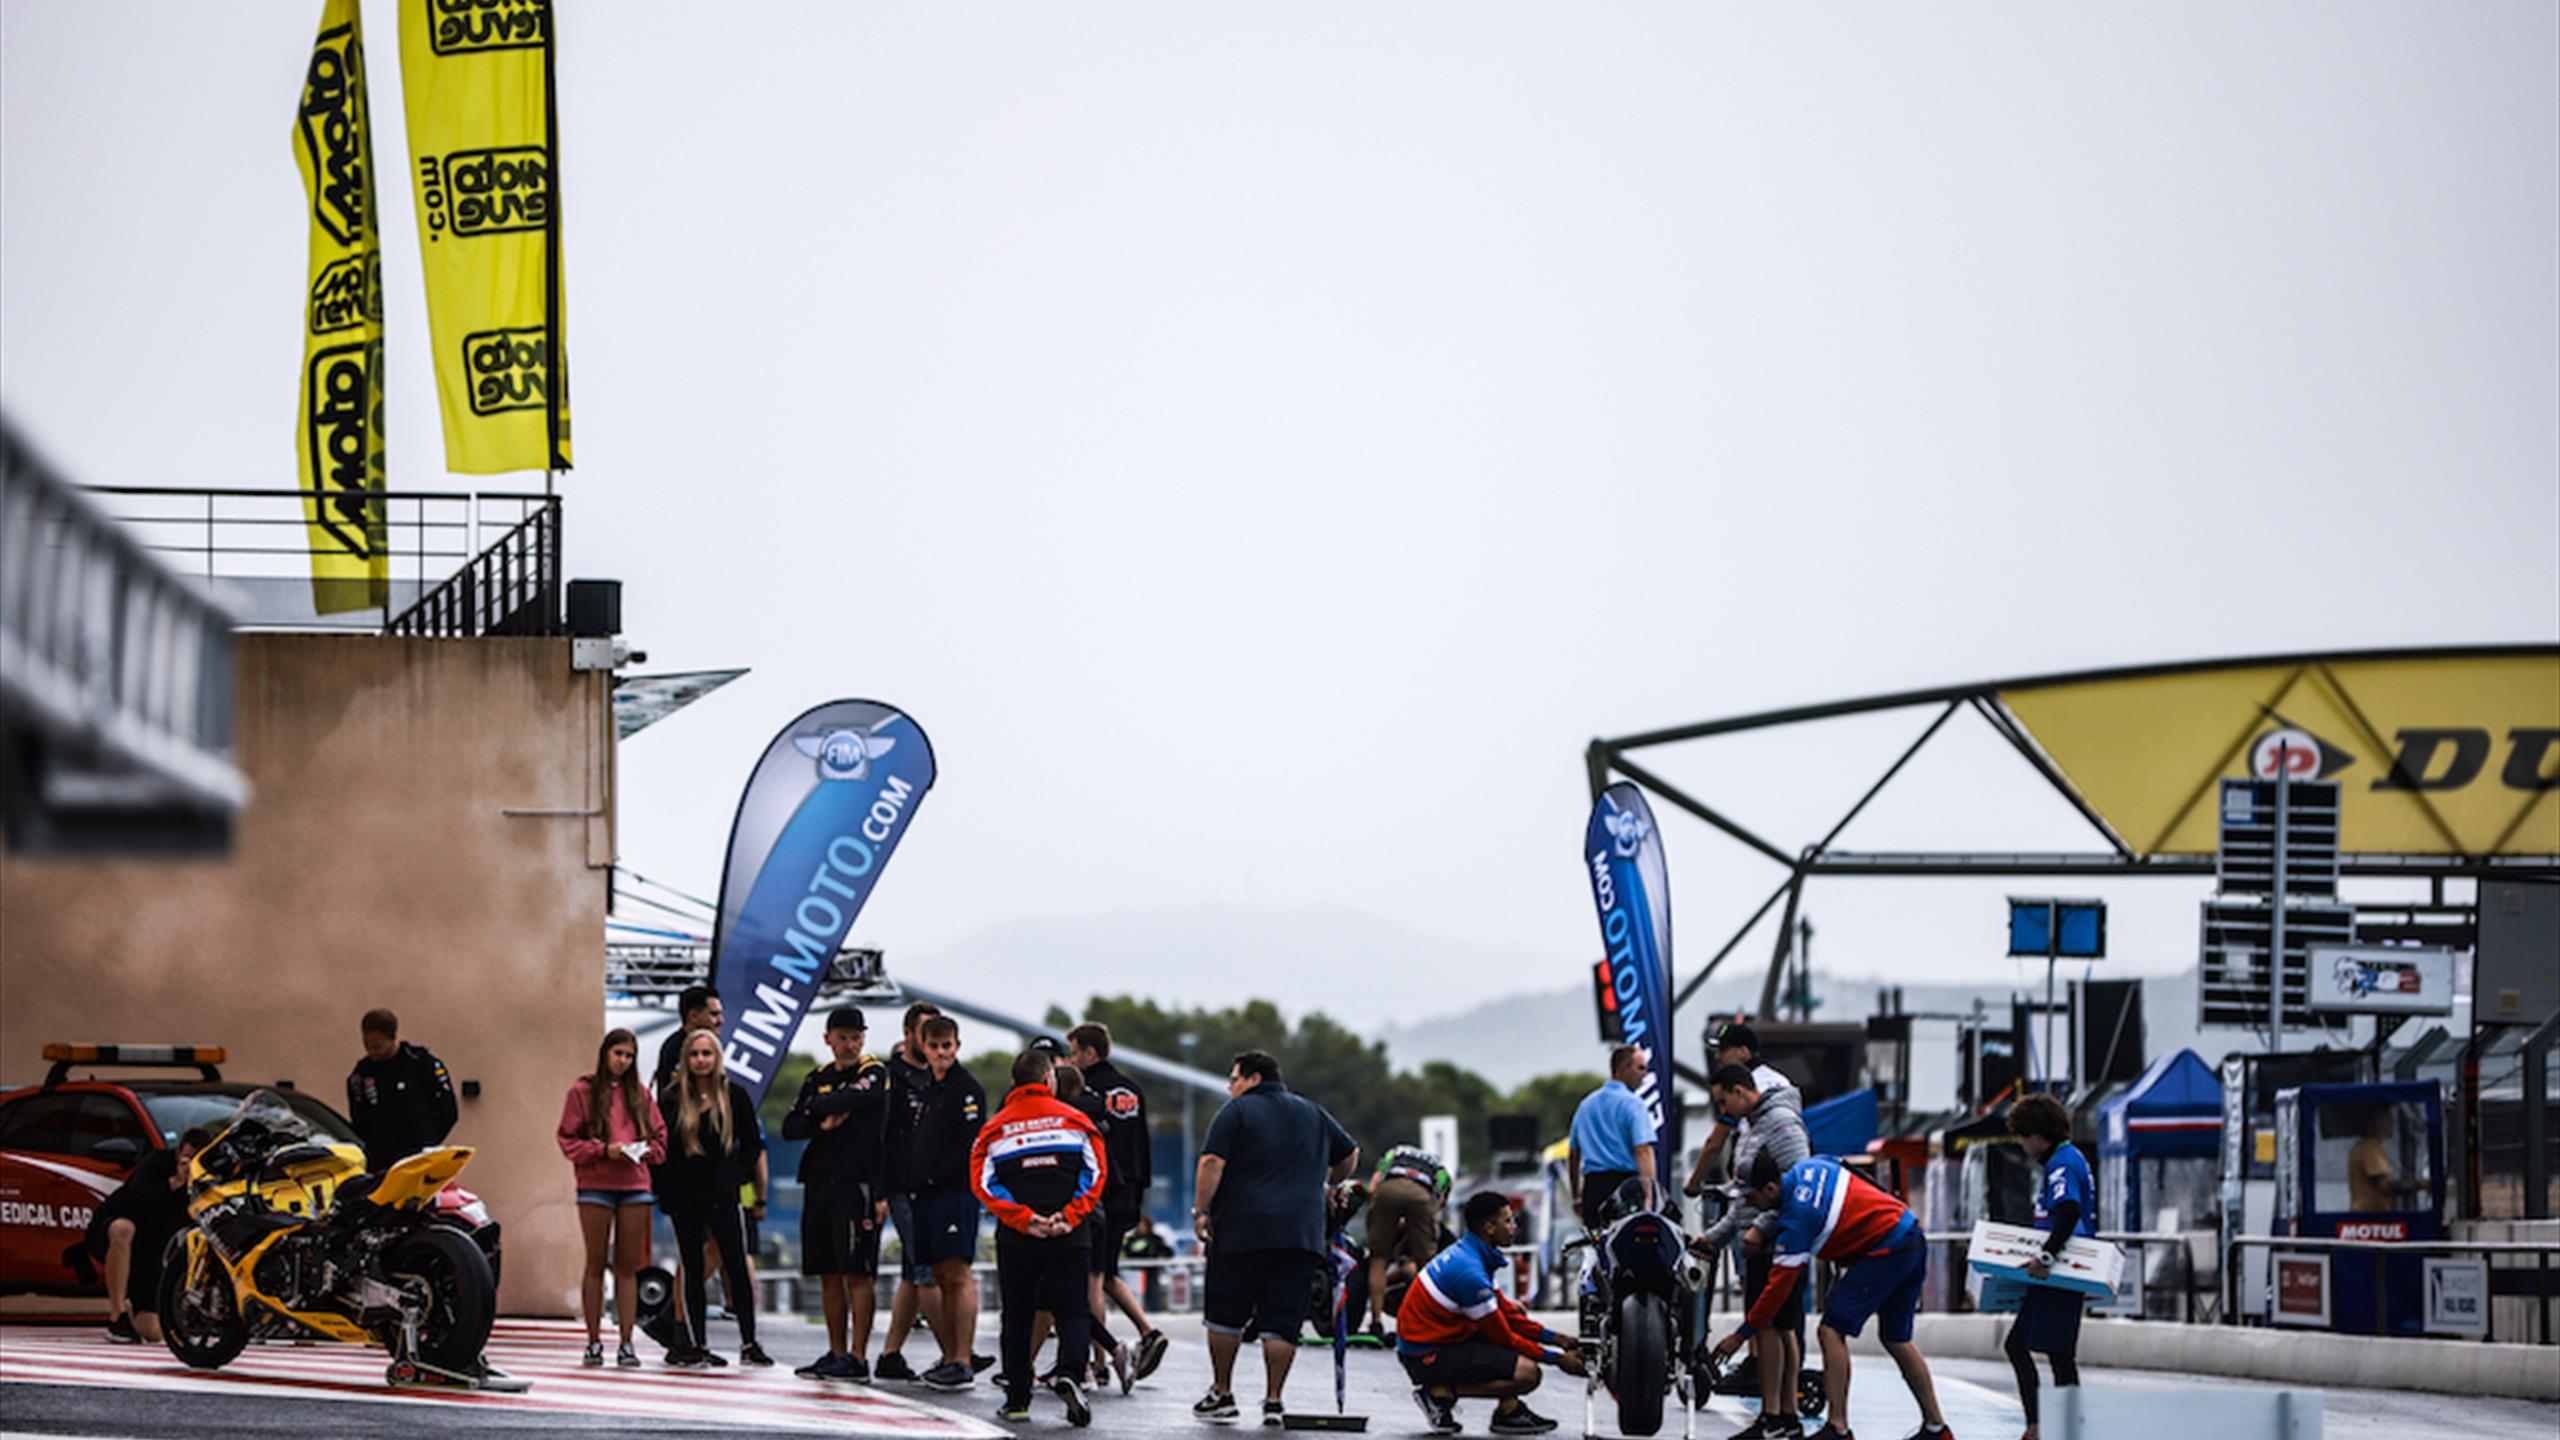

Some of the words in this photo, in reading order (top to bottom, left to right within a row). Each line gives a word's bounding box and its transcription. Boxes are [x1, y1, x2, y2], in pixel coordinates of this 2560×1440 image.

[827, 743, 861, 765] FIM
[723, 775, 912, 1083] FIM-MOTO.COM
[0, 1201, 57, 1228] EDICAL
[2340, 1223, 2405, 1240] MOTUL
